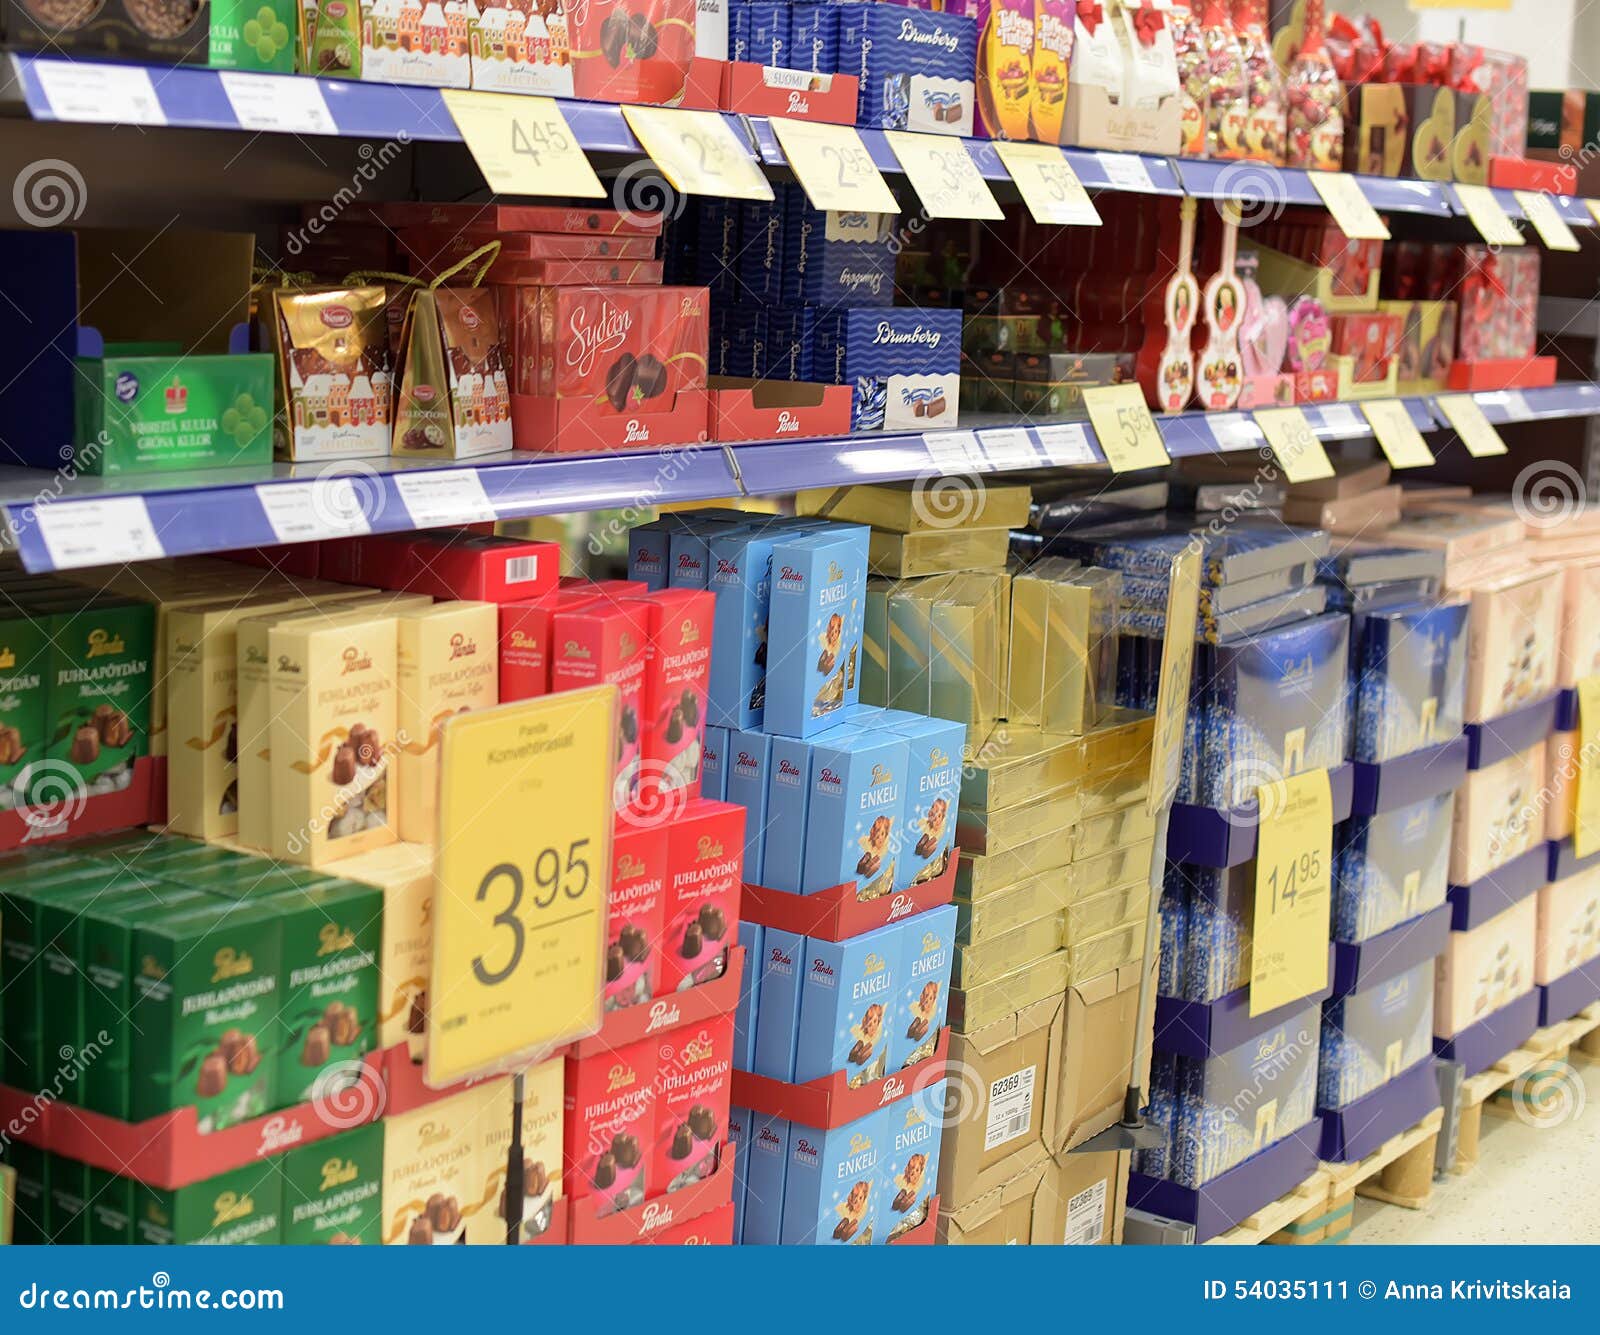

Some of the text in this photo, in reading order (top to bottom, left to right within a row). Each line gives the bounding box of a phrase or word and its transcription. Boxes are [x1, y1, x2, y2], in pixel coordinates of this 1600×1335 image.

[897, 17, 960, 53] Brunberg
[786, 91, 809, 114] Panda
[567, 302, 633, 377] Sydän
[872, 321, 941, 348] Brunberg
[623, 419, 650, 443] Panda
[776, 411, 799, 433] Panda
[679, 553, 702, 569] Panda
[717, 559, 738, 575] Panda
[780, 566, 803, 582] Panda
[819, 581, 848, 606] ENKELI
[738, 751, 758, 768] Panda
[779, 759, 800, 776] Panda
[821, 768, 841, 785] Panda
[919, 767, 956, 793] ENKELI
[860, 784, 899, 810] ENKELI
[695, 835, 724, 863] Panda
[672, 860, 739, 889] JUHLAPÖYDÄN
[886, 894, 913, 922] Panda
[771, 948, 792, 965] Panda
[812, 958, 834, 976] Panda
[911, 950, 946, 977] ENKELI
[852, 972, 892, 1000] ENKELI
[645, 1001, 681, 1033] Panda
[606, 1064, 636, 1094] Panda
[663, 1060, 729, 1092] JUHLAPÖYDÄN
[992, 1074, 1019, 1097] 62369
[879, 1077, 905, 1105] Panda
[256, 1116, 304, 1156] Panda
[760, 1127, 780, 1145] Panda
[798, 1139, 817, 1156] Panda
[895, 1122, 932, 1151] ENKELI
[838, 1150, 878, 1179] ENKELI
[638, 1202, 673, 1236] Panda
